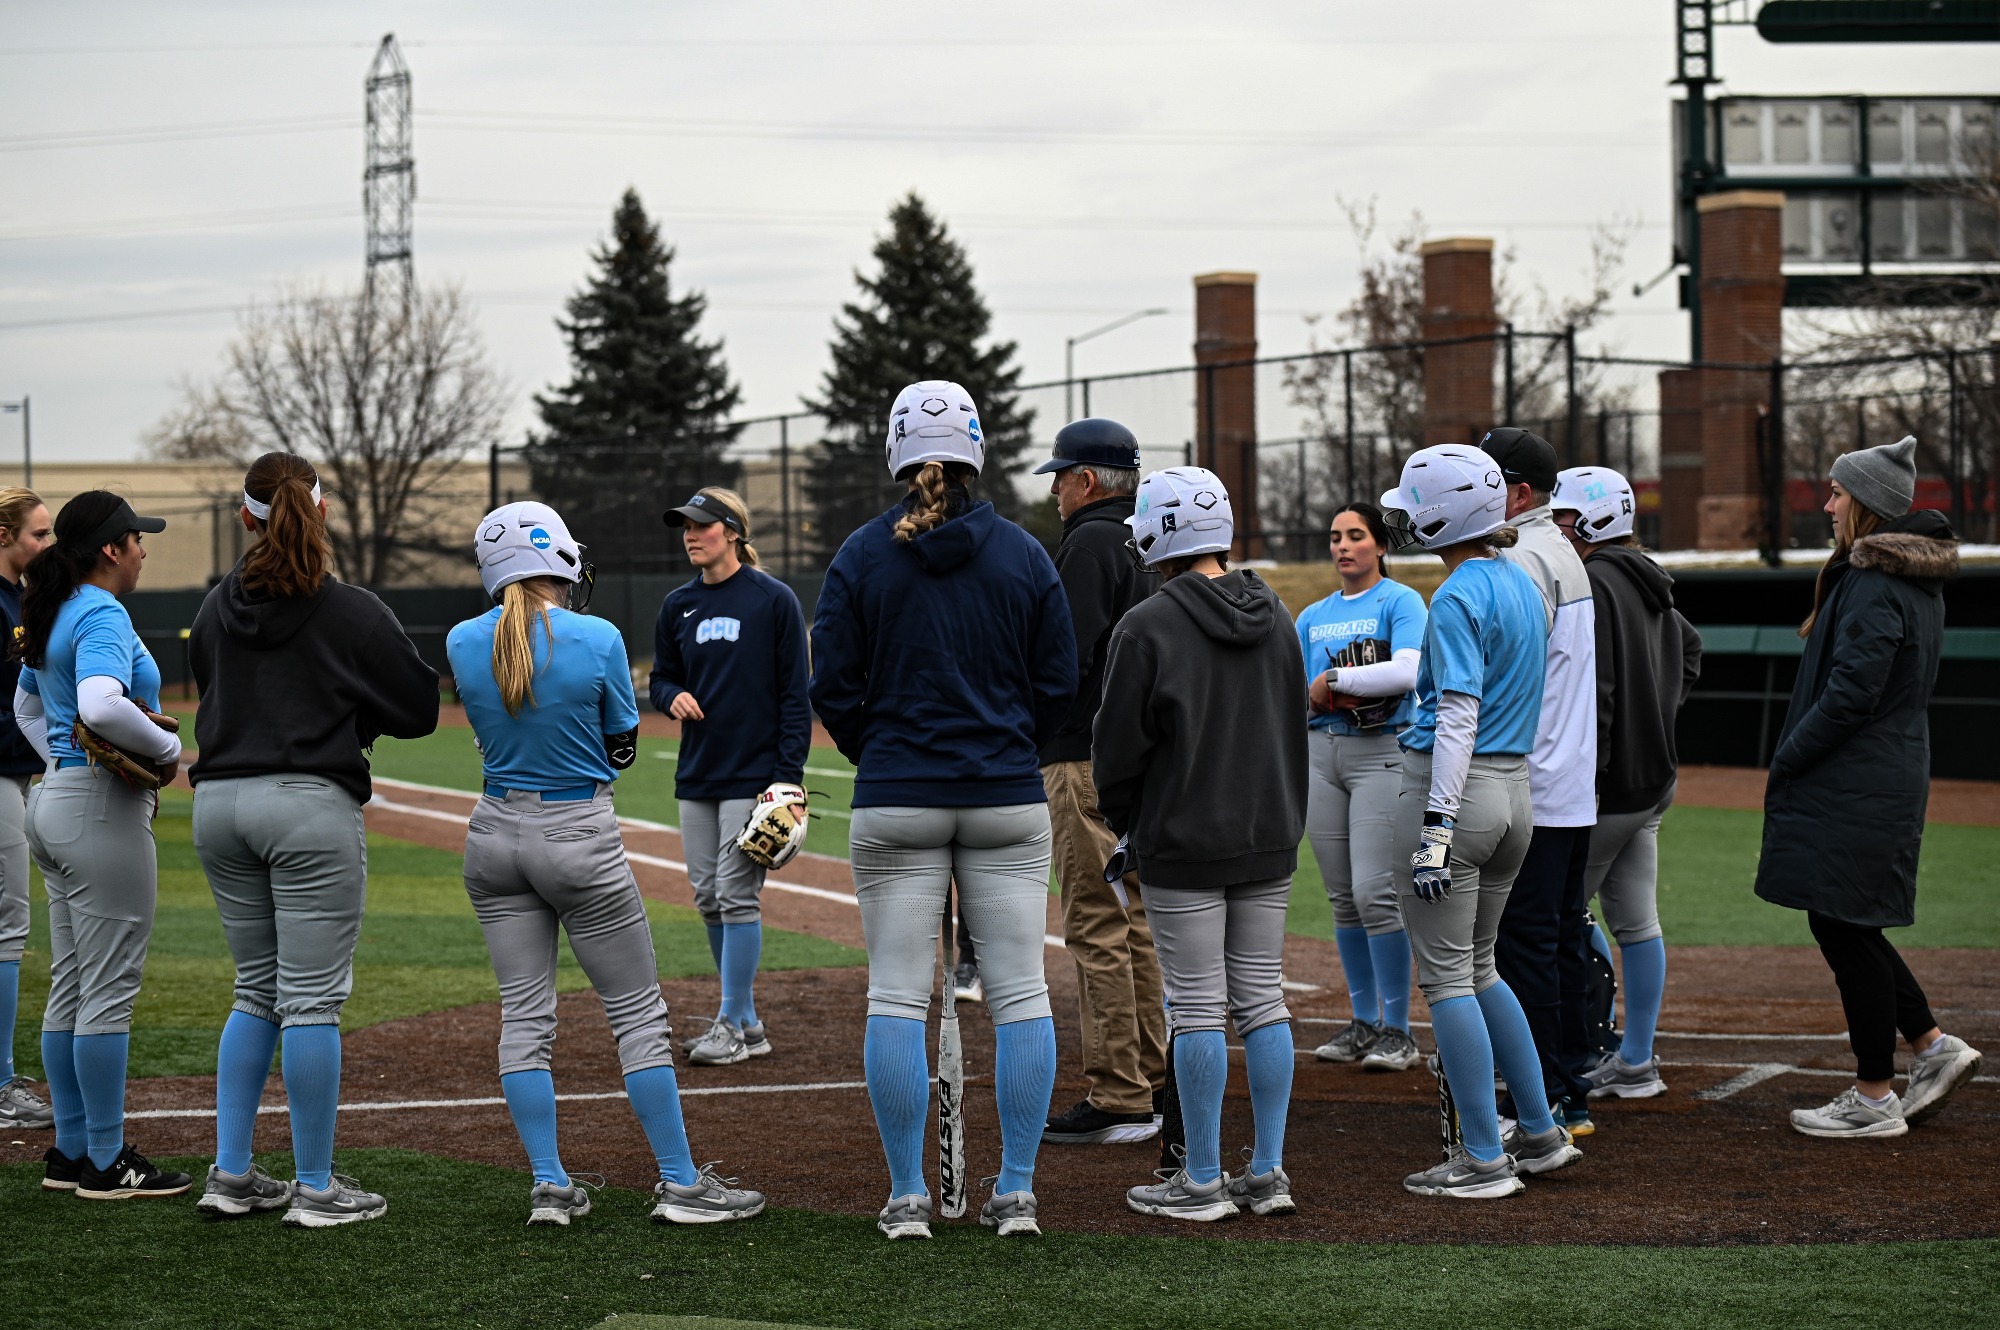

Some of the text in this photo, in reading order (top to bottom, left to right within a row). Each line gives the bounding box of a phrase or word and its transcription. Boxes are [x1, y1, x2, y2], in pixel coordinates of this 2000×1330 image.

[1411, 487, 1421, 504] 1
[532, 537, 551, 545] NCAA
[696, 616, 740, 645] CCU
[1309, 618, 1378, 643] COUGARS
[1436, 1047, 1453, 1162] HOST
[939, 1075, 955, 1208] EASTON
